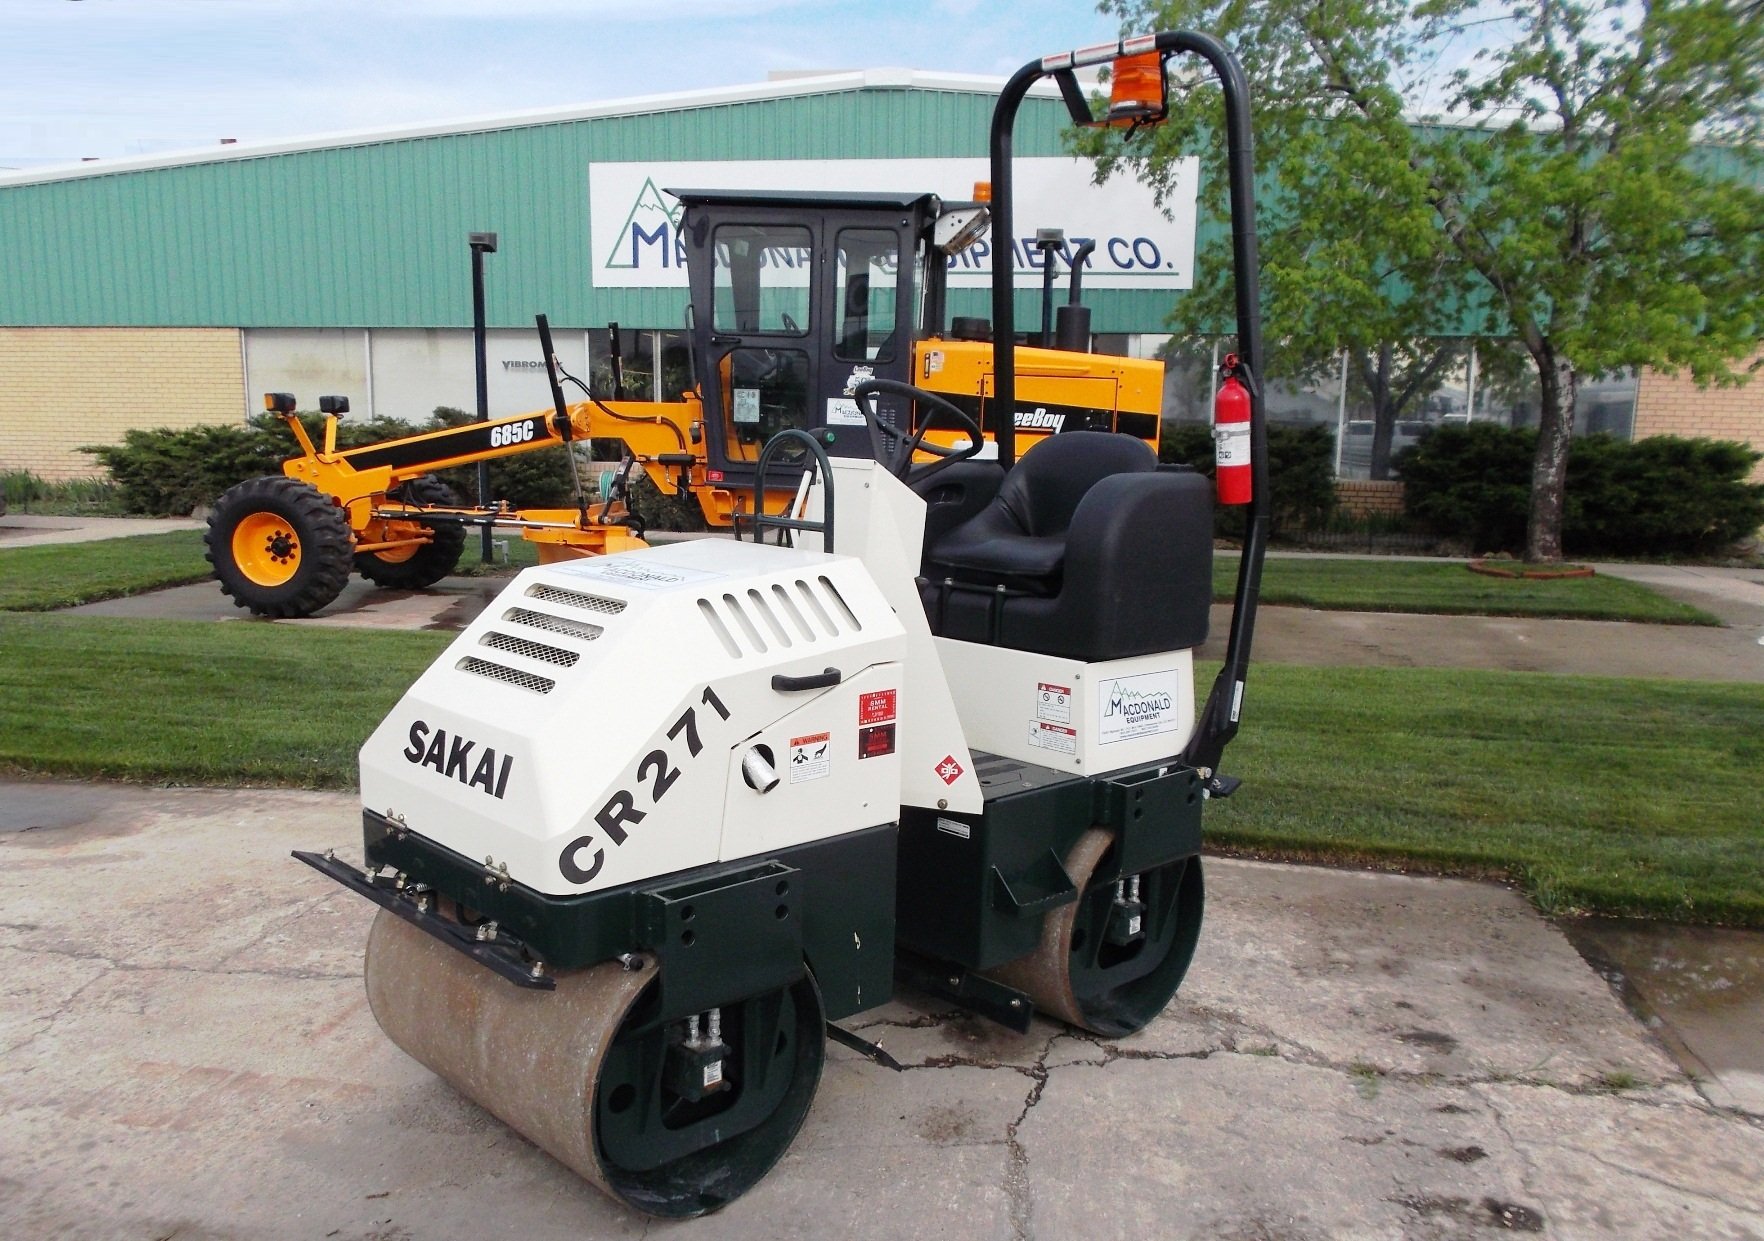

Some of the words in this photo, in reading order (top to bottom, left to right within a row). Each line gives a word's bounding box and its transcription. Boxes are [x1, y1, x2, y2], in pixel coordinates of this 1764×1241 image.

[1107, 236, 1174, 269] CO.
[502, 360, 563, 373] VIBROM
[490, 419, 534, 448] 685C
[1014, 407, 1066, 434] eeBoy
[1111, 697, 1171, 717] MACDONALD
[1126, 711, 1161, 724] EQUIPMENT
[403, 719, 514, 800] SAKAI
